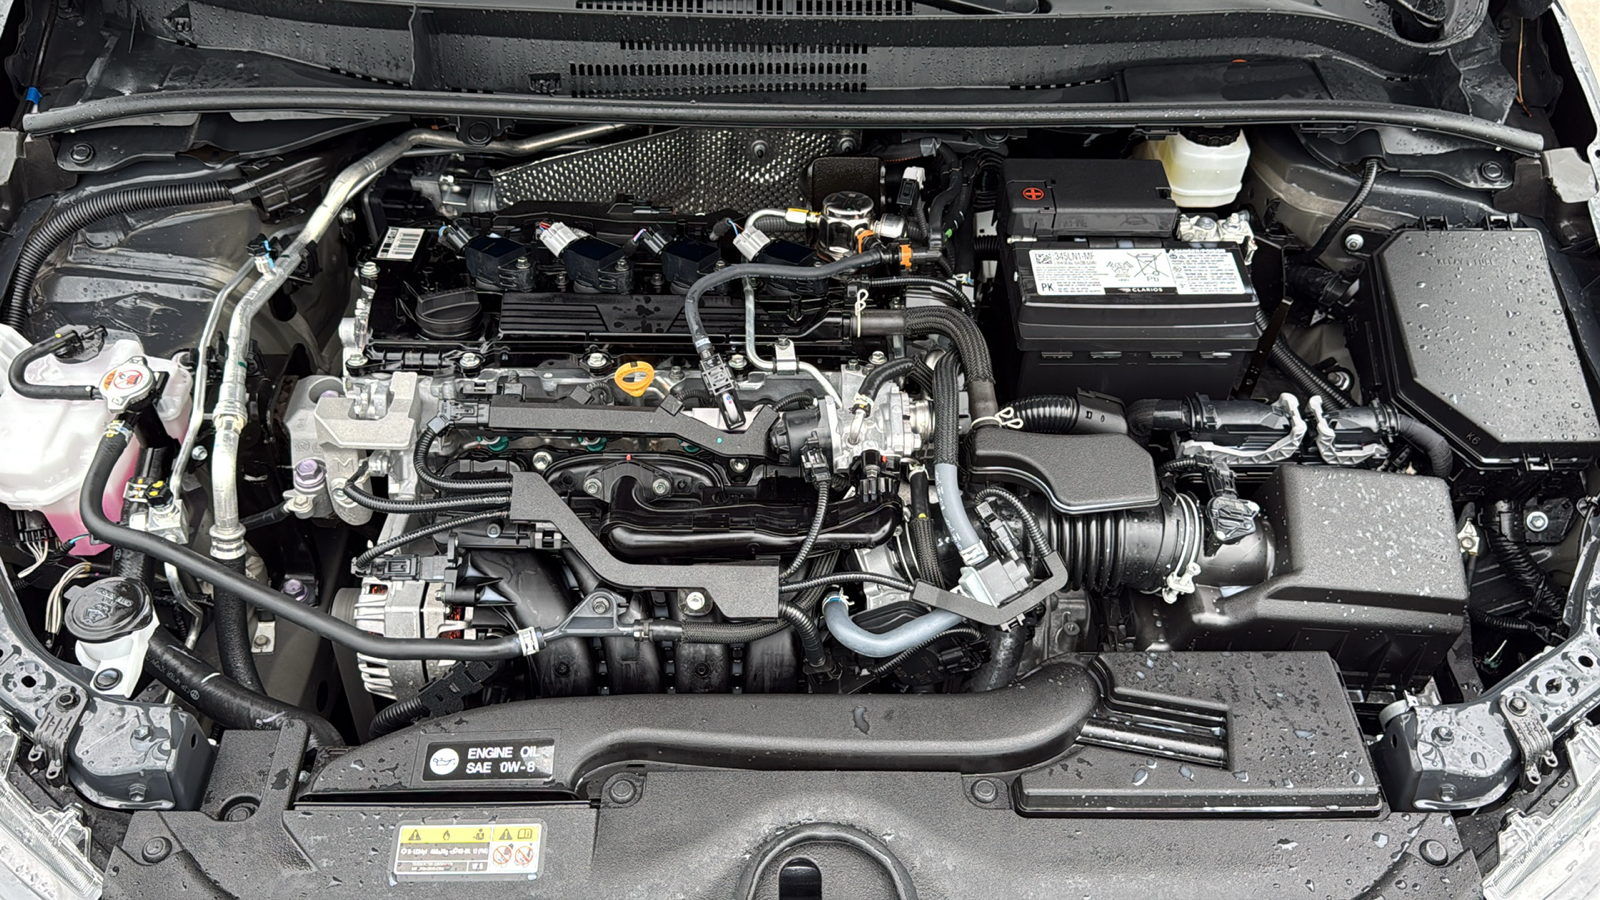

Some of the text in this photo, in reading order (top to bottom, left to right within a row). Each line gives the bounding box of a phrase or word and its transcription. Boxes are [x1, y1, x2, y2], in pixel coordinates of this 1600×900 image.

[1041, 282, 1055, 292] PK
[1465, 431, 1481, 445] K6
[467, 745, 540, 759] ENGINE OIL
[466, 760, 536, 774] SAE 0W-8
